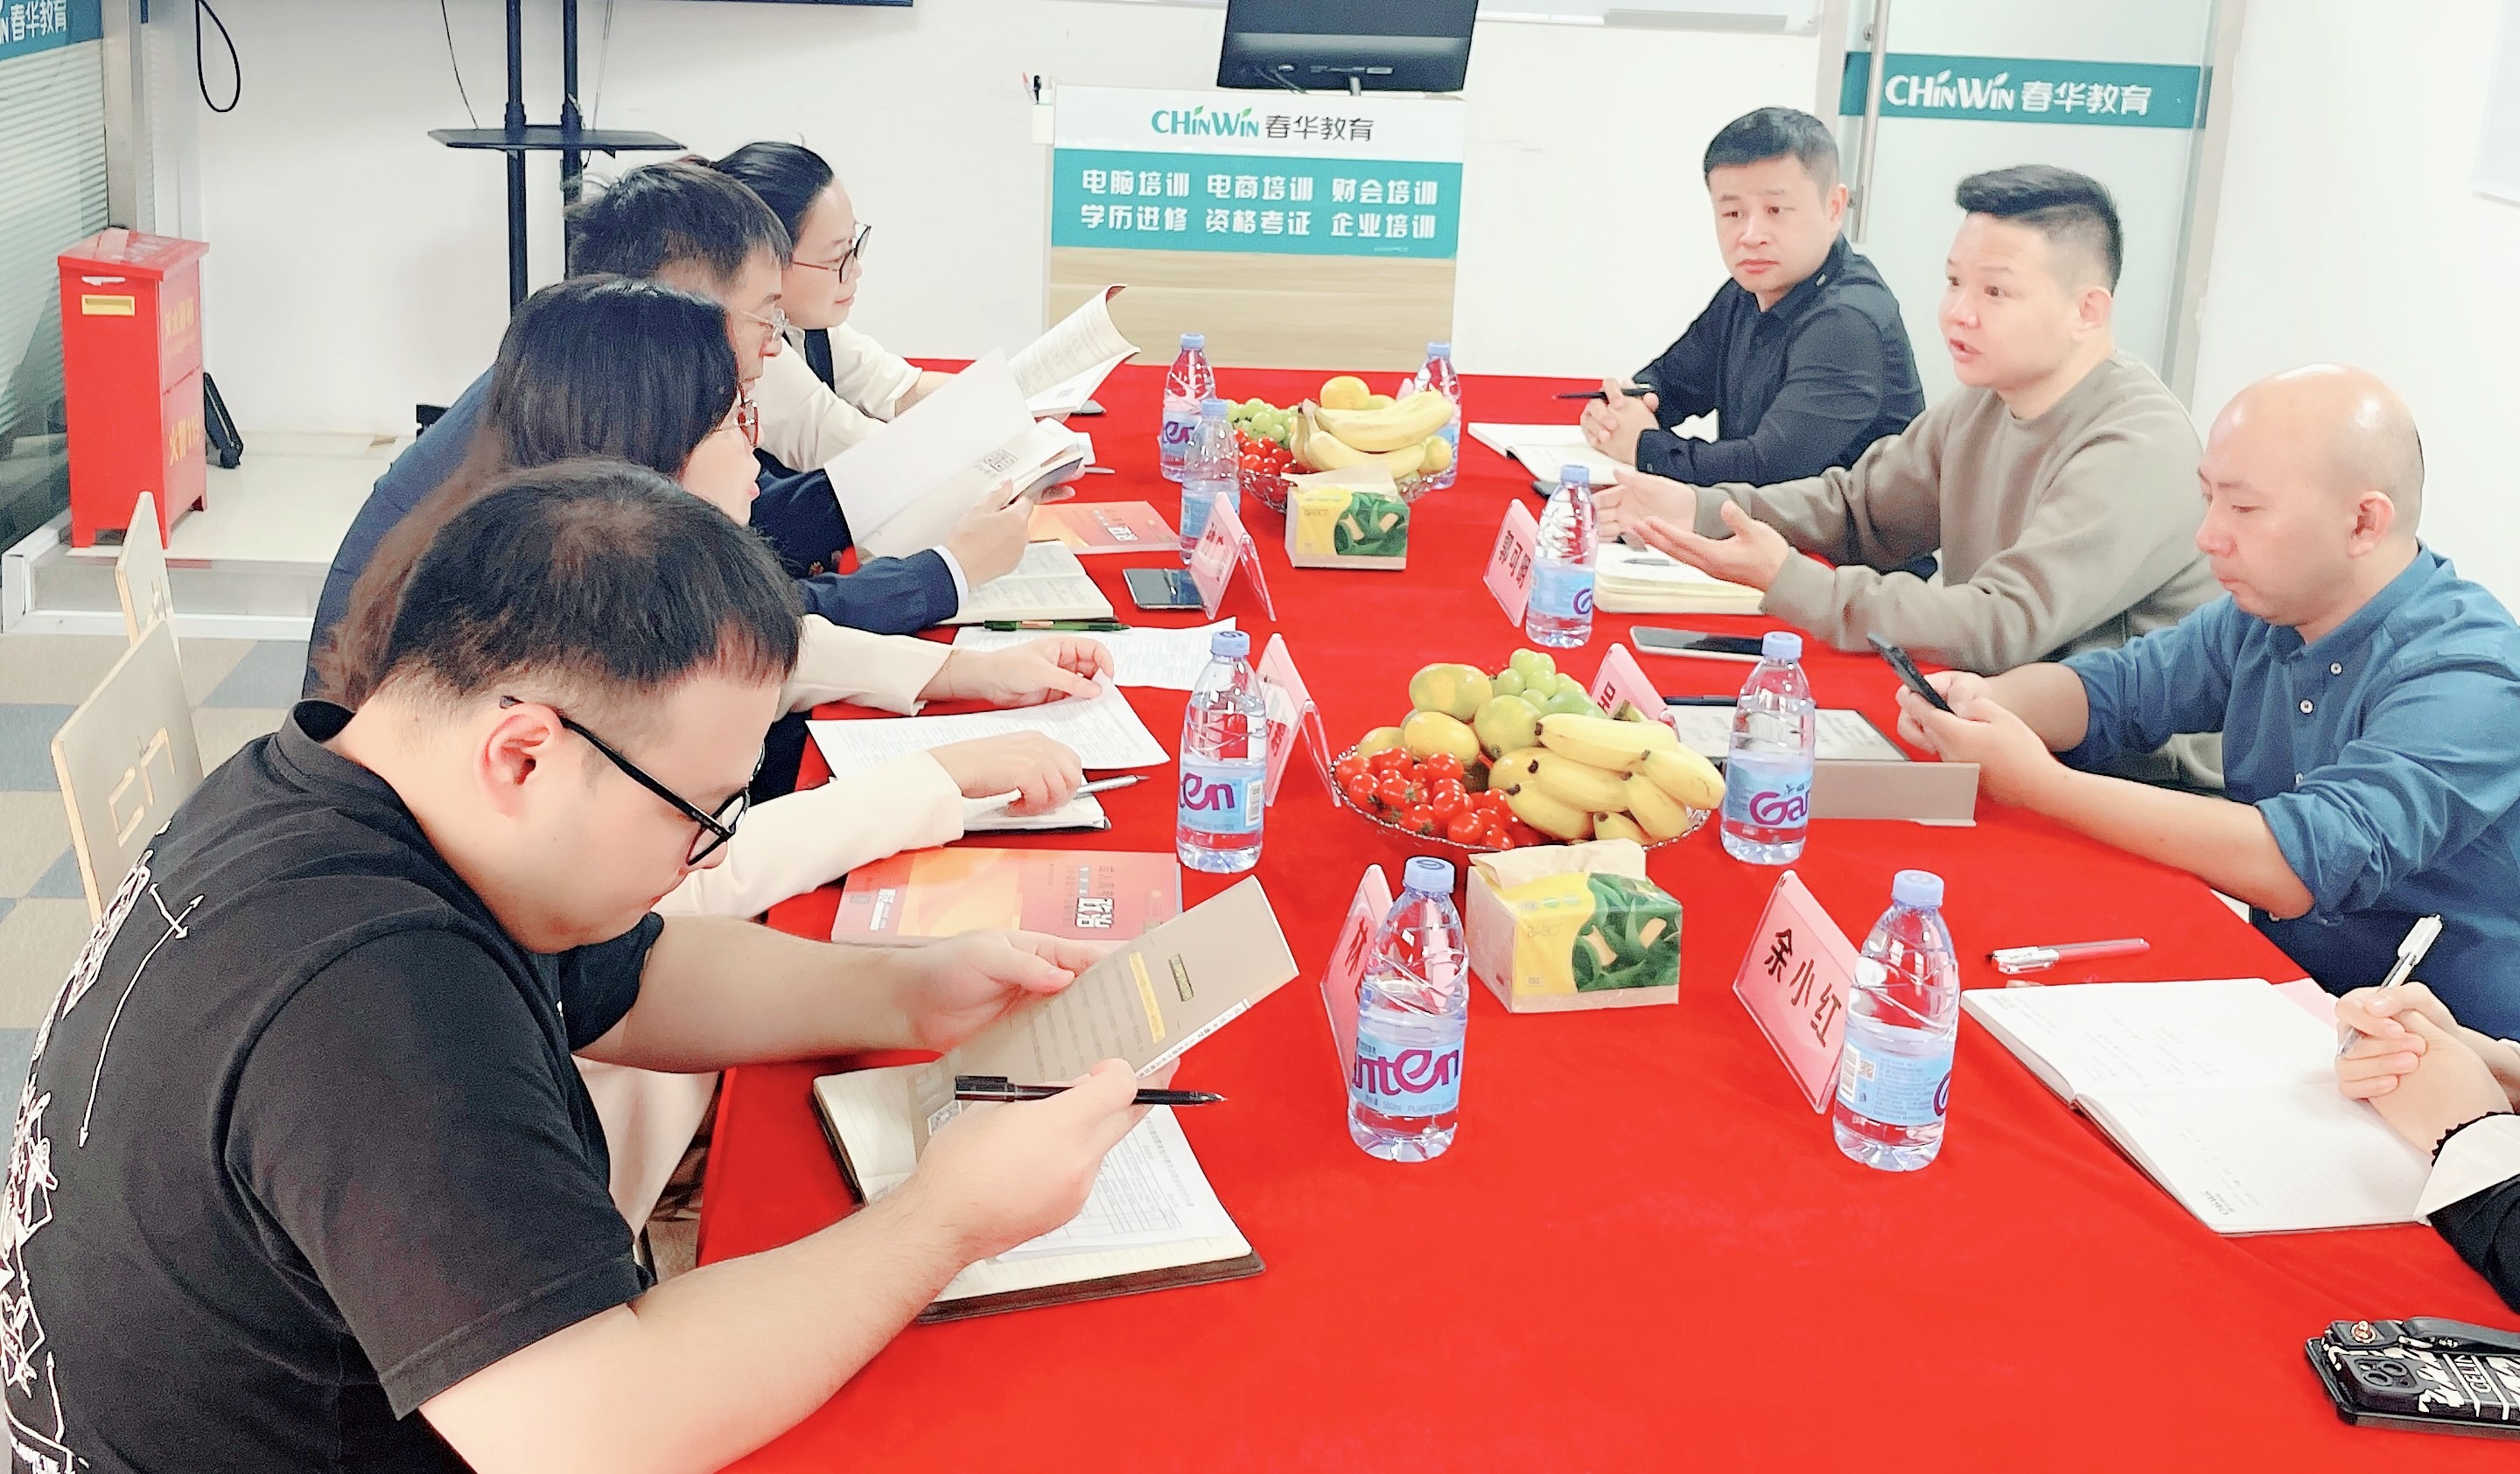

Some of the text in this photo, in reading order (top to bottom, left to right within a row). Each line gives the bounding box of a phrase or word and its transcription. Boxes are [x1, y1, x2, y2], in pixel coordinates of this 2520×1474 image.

[10, 0, 66, 42] 春华教育
[2020, 80, 2152, 116] 春华教育
[1265, 115, 1375, 143] 春华教育
[1082, 169, 1439, 206] 电脑培训 电商培训 财会培训
[1080, 204, 1437, 241] 学历进修 资格考证 企业培训
[1180, 772, 1236, 811] en
[1076, 897, 1115, 929] 政治
[1764, 927, 1841, 1048] 余小红
